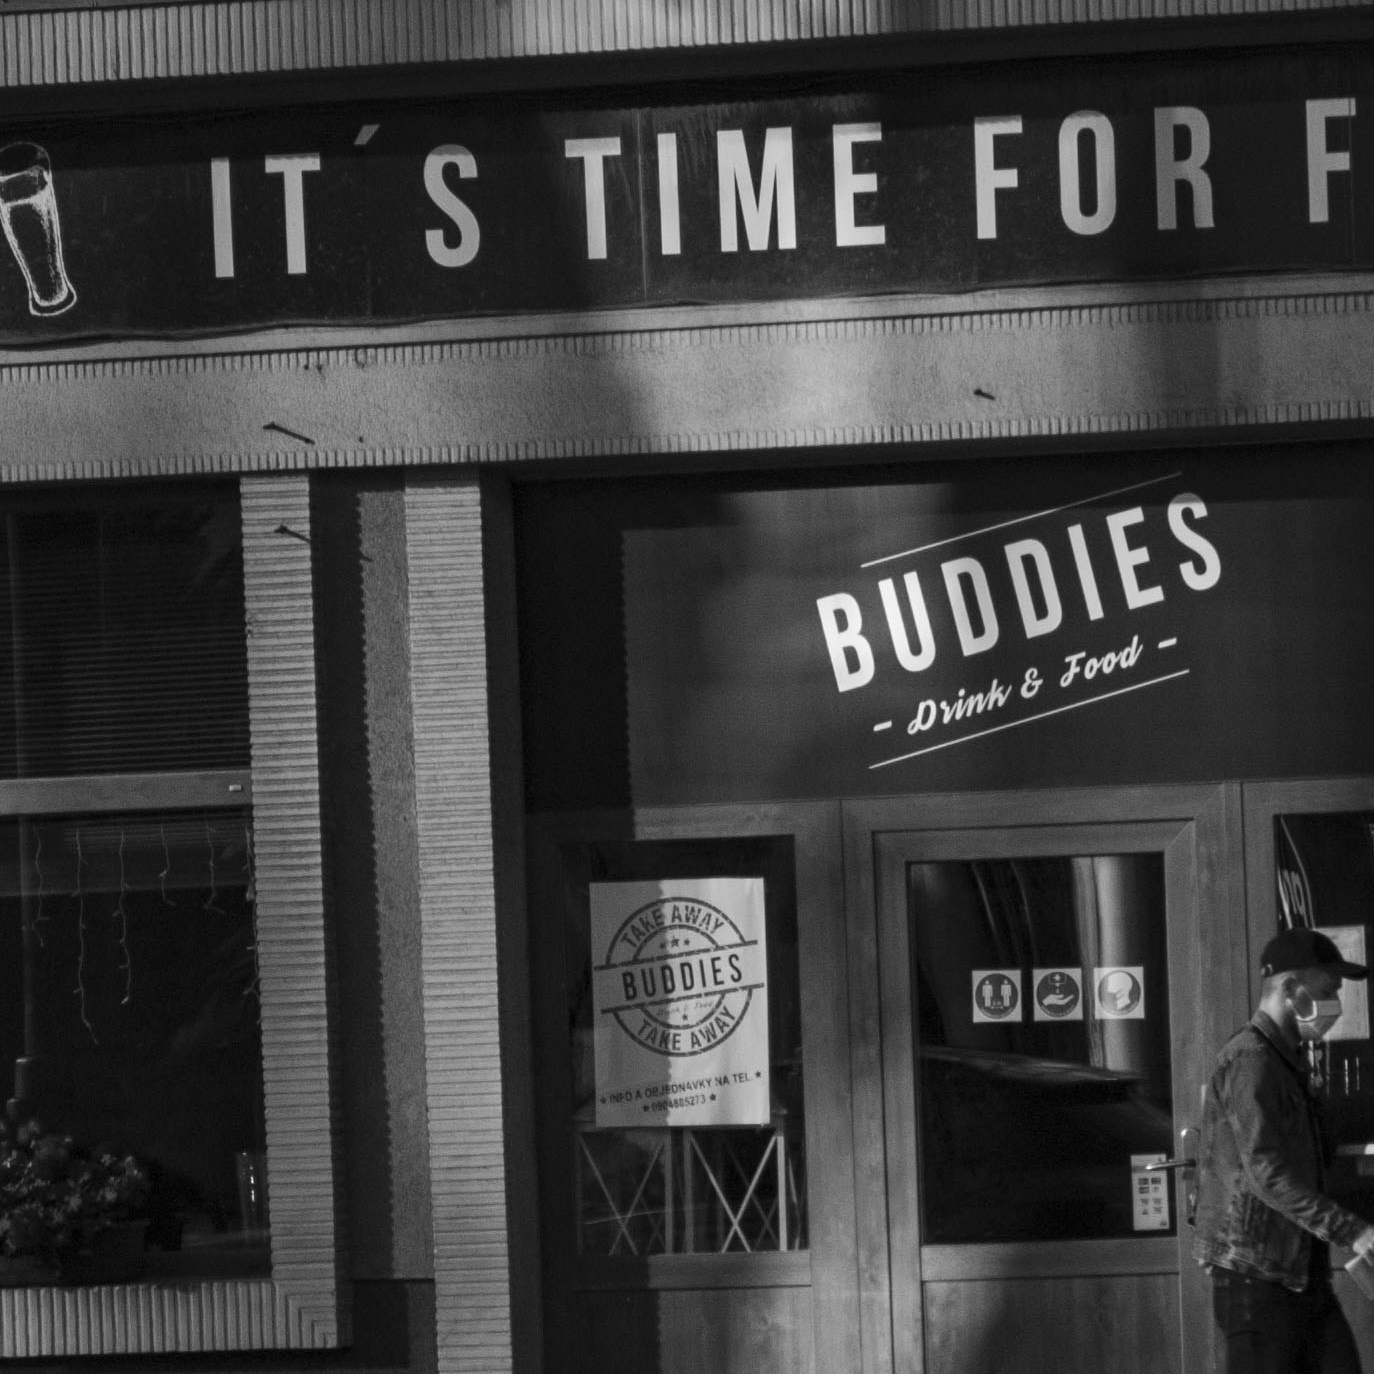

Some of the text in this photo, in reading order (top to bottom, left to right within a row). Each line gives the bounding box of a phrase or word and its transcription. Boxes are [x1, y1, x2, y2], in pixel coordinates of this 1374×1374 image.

[565, 121, 886, 260] TIME
[974, 106, 1215, 240] FOR
[816, 492, 1222, 693] BUDDIES
[907, 634, 1144, 735] Drink & Food
[621, 904, 724, 948] TAKE AWAY
[621, 953, 743, 1001] BUDDIES
[636, 1015, 682, 1051] TAKE
[690, 1006, 736, 1050] AWAY
